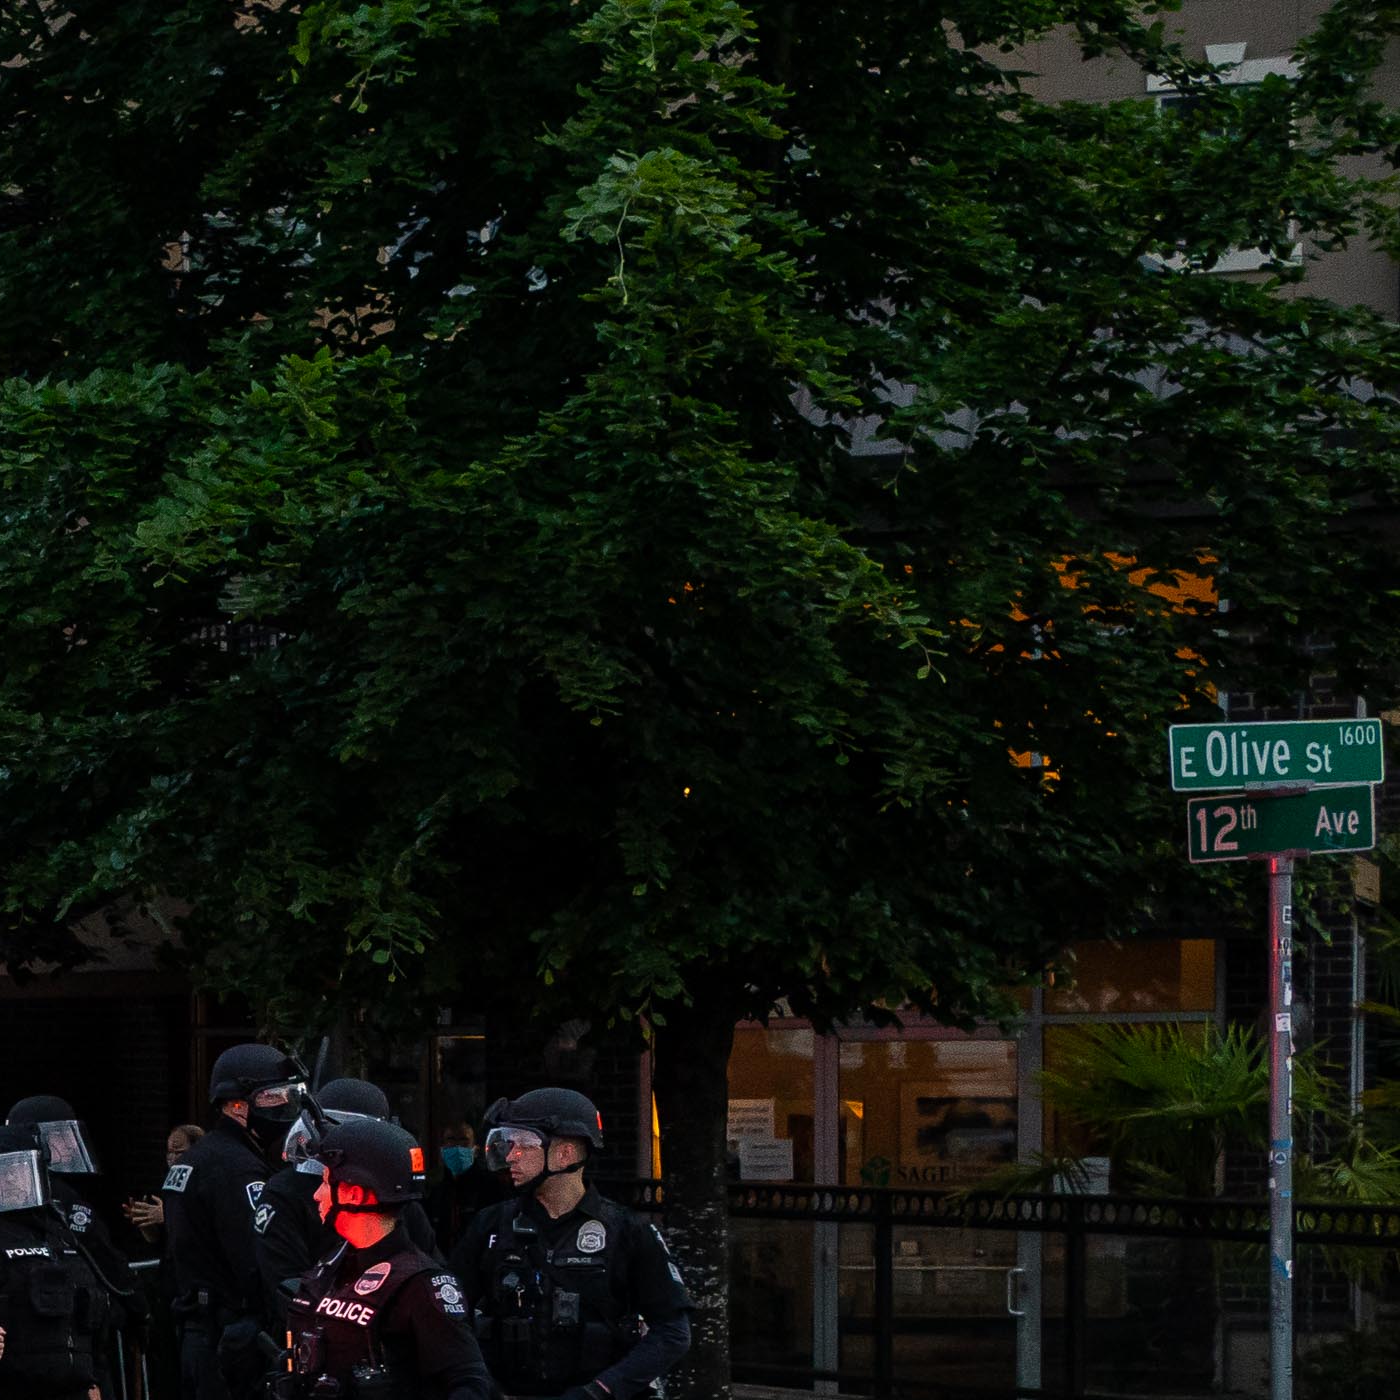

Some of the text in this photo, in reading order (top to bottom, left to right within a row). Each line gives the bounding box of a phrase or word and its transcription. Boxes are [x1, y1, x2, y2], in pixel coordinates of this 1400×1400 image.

[1180, 725, 1375, 777] E Olive St 1600
[1196, 804, 1360, 852] 12th Ave
[5, 1247, 50, 1259] POLICE
[316, 1297, 375, 1326] POLICE
[444, 1304, 465, 1313] POLICE
